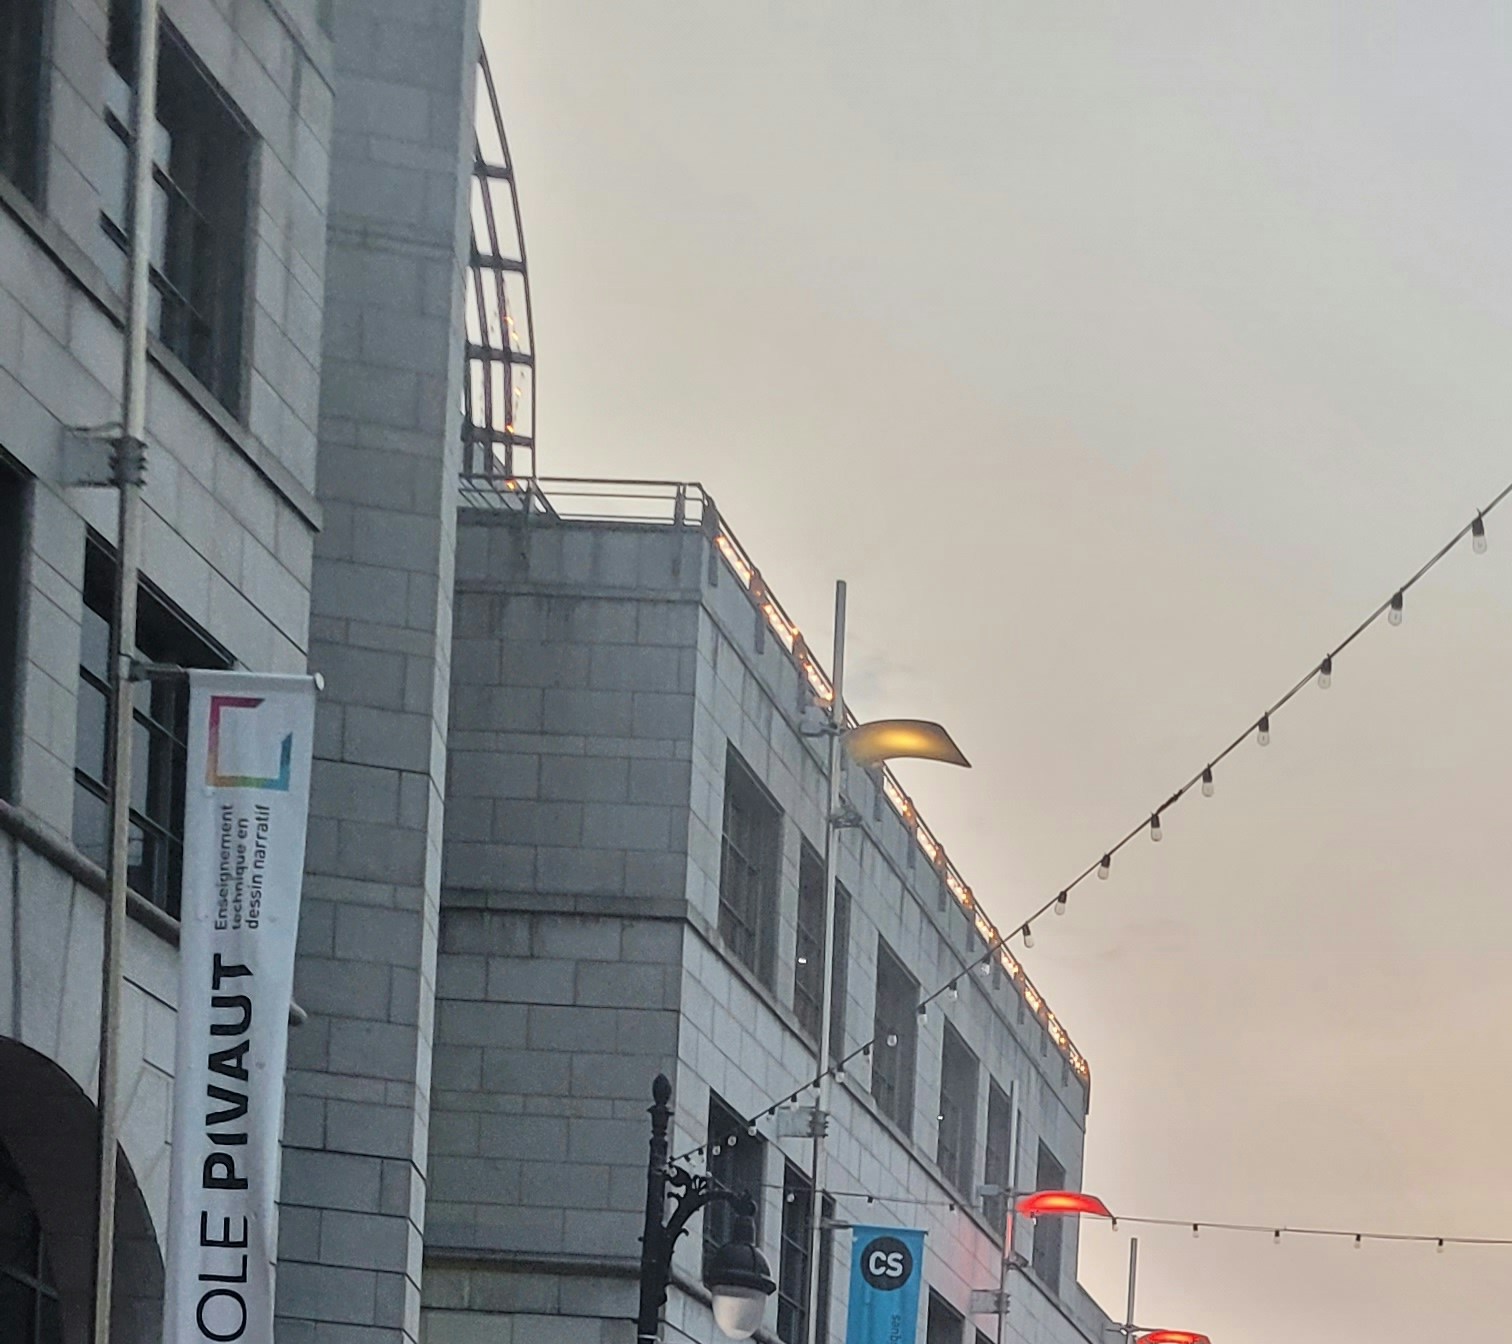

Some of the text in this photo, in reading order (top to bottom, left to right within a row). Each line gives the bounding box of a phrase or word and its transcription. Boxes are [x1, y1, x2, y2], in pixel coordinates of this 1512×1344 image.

[215, 804, 234, 930] Enseignement
[232, 818, 249, 930] technique en
[245, 804, 270, 929] dessin narratif
[202, 952, 254, 1191] PIVAUT
[869, 1249, 903, 1278] CS
